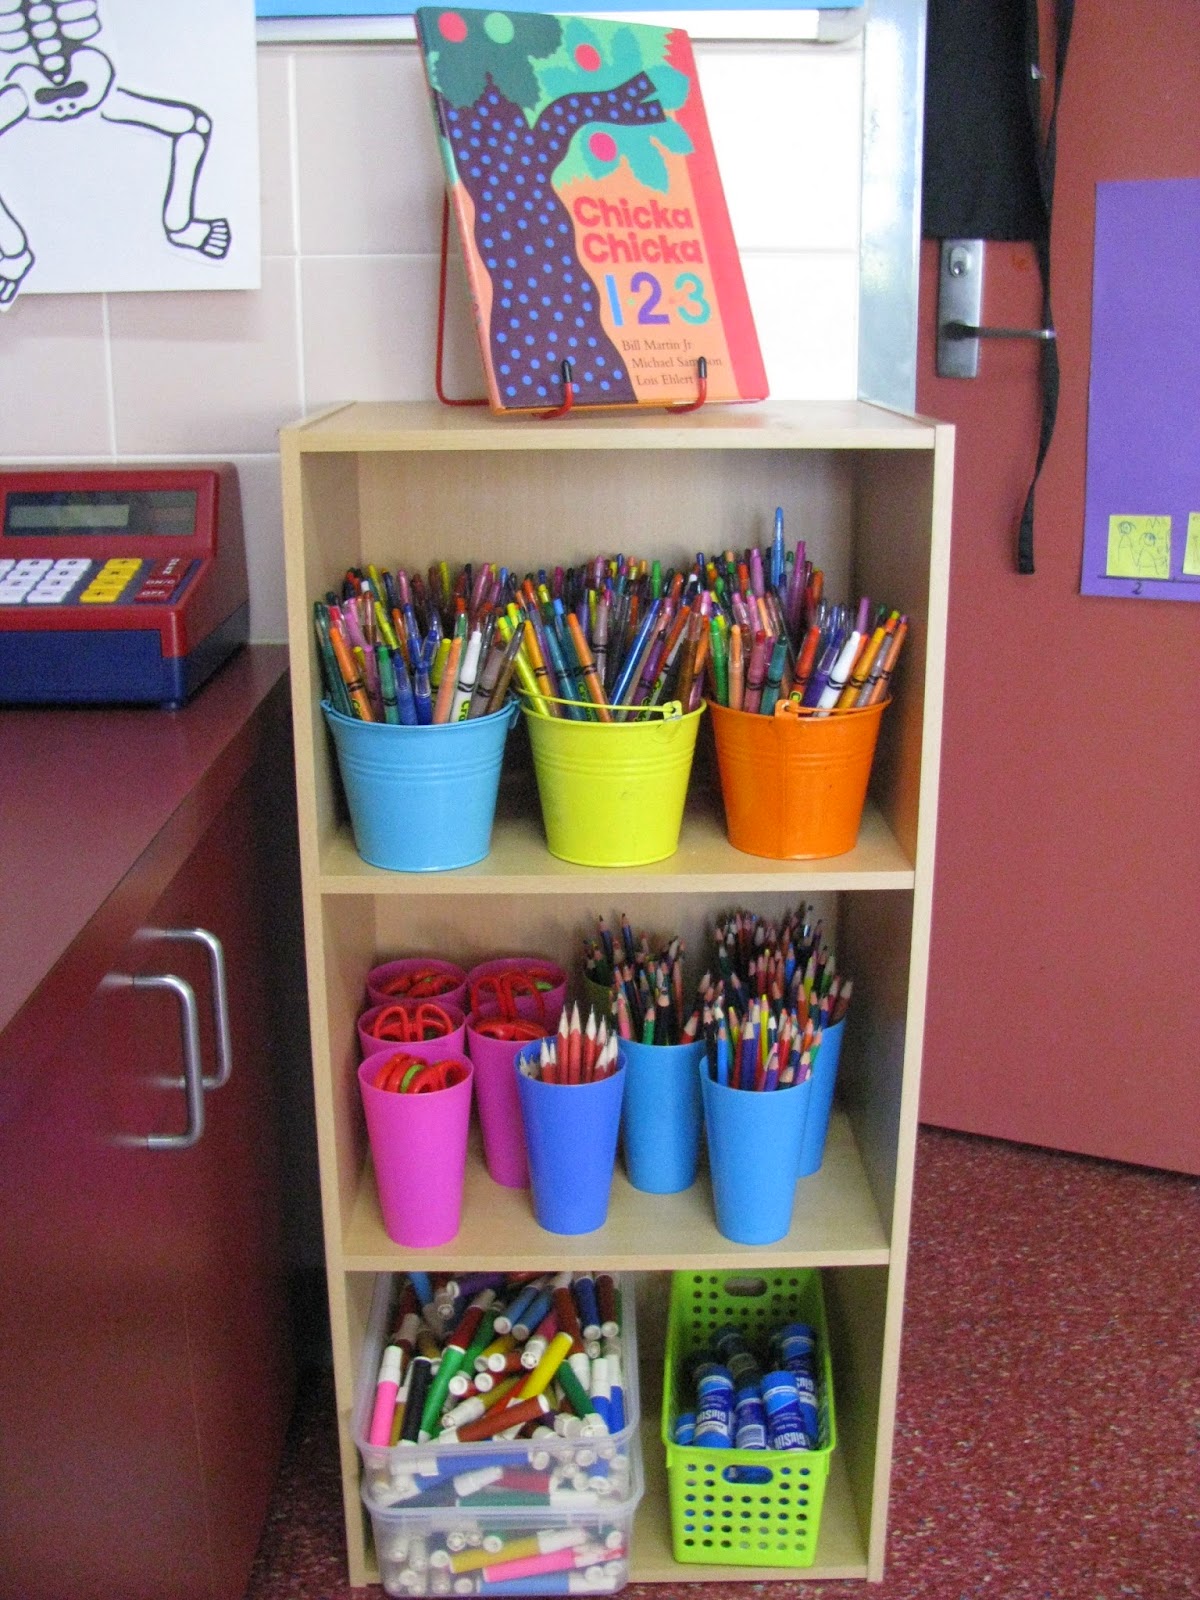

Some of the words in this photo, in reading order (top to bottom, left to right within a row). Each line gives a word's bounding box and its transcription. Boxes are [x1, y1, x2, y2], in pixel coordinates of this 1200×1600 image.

[573, 196, 694, 229] Chicka
[582, 231, 704, 264] Chicka
[622, 340, 640, 351] Bill
[644, 339, 681, 351] Martin
[682, 338, 692, 352] Jr
[632, 357, 674, 369] Michael
[677, 357, 722, 368] Samson
[636, 375, 659, 386] Lois
[661, 373, 694, 385] Ehlert
